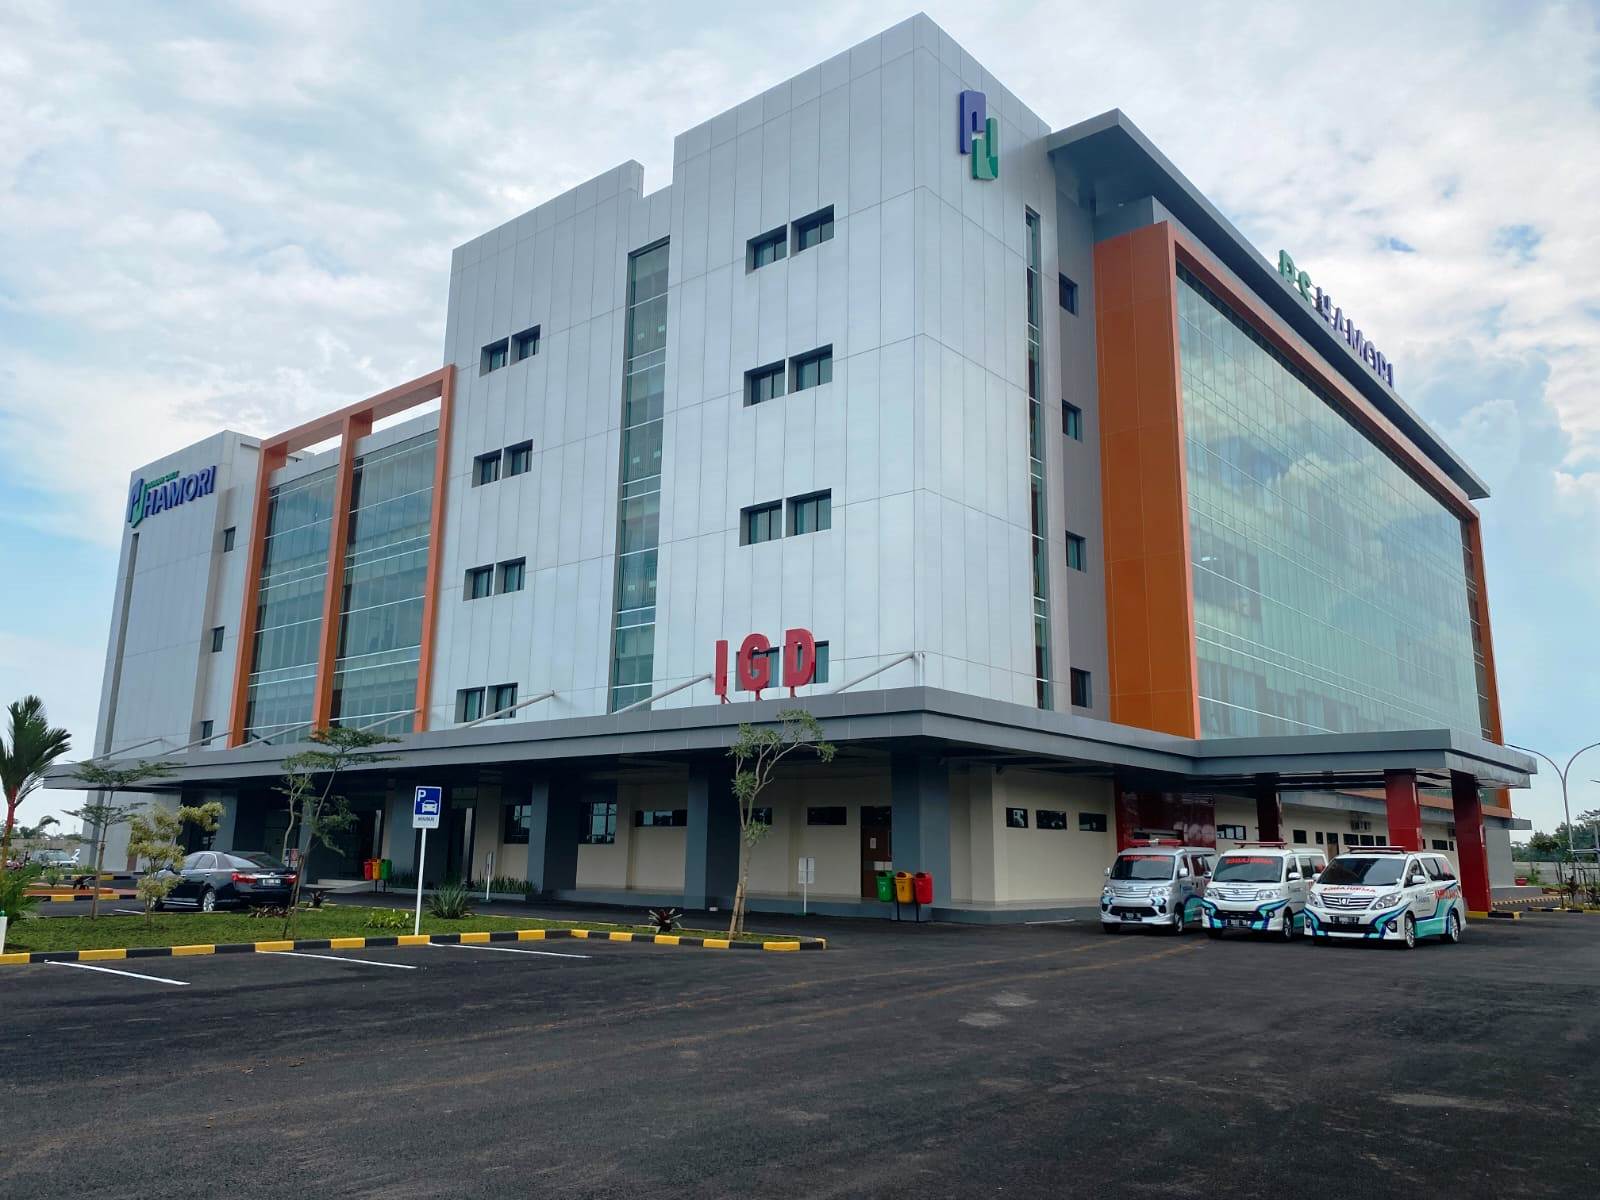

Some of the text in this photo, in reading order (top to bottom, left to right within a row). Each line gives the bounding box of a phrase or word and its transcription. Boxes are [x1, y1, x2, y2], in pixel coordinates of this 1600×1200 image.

[1315, 286, 1394, 389] HAMORI
[144, 465, 216, 518] HAMORI
[714, 628, 816, 696] IGD
[417, 789, 427, 802] P
